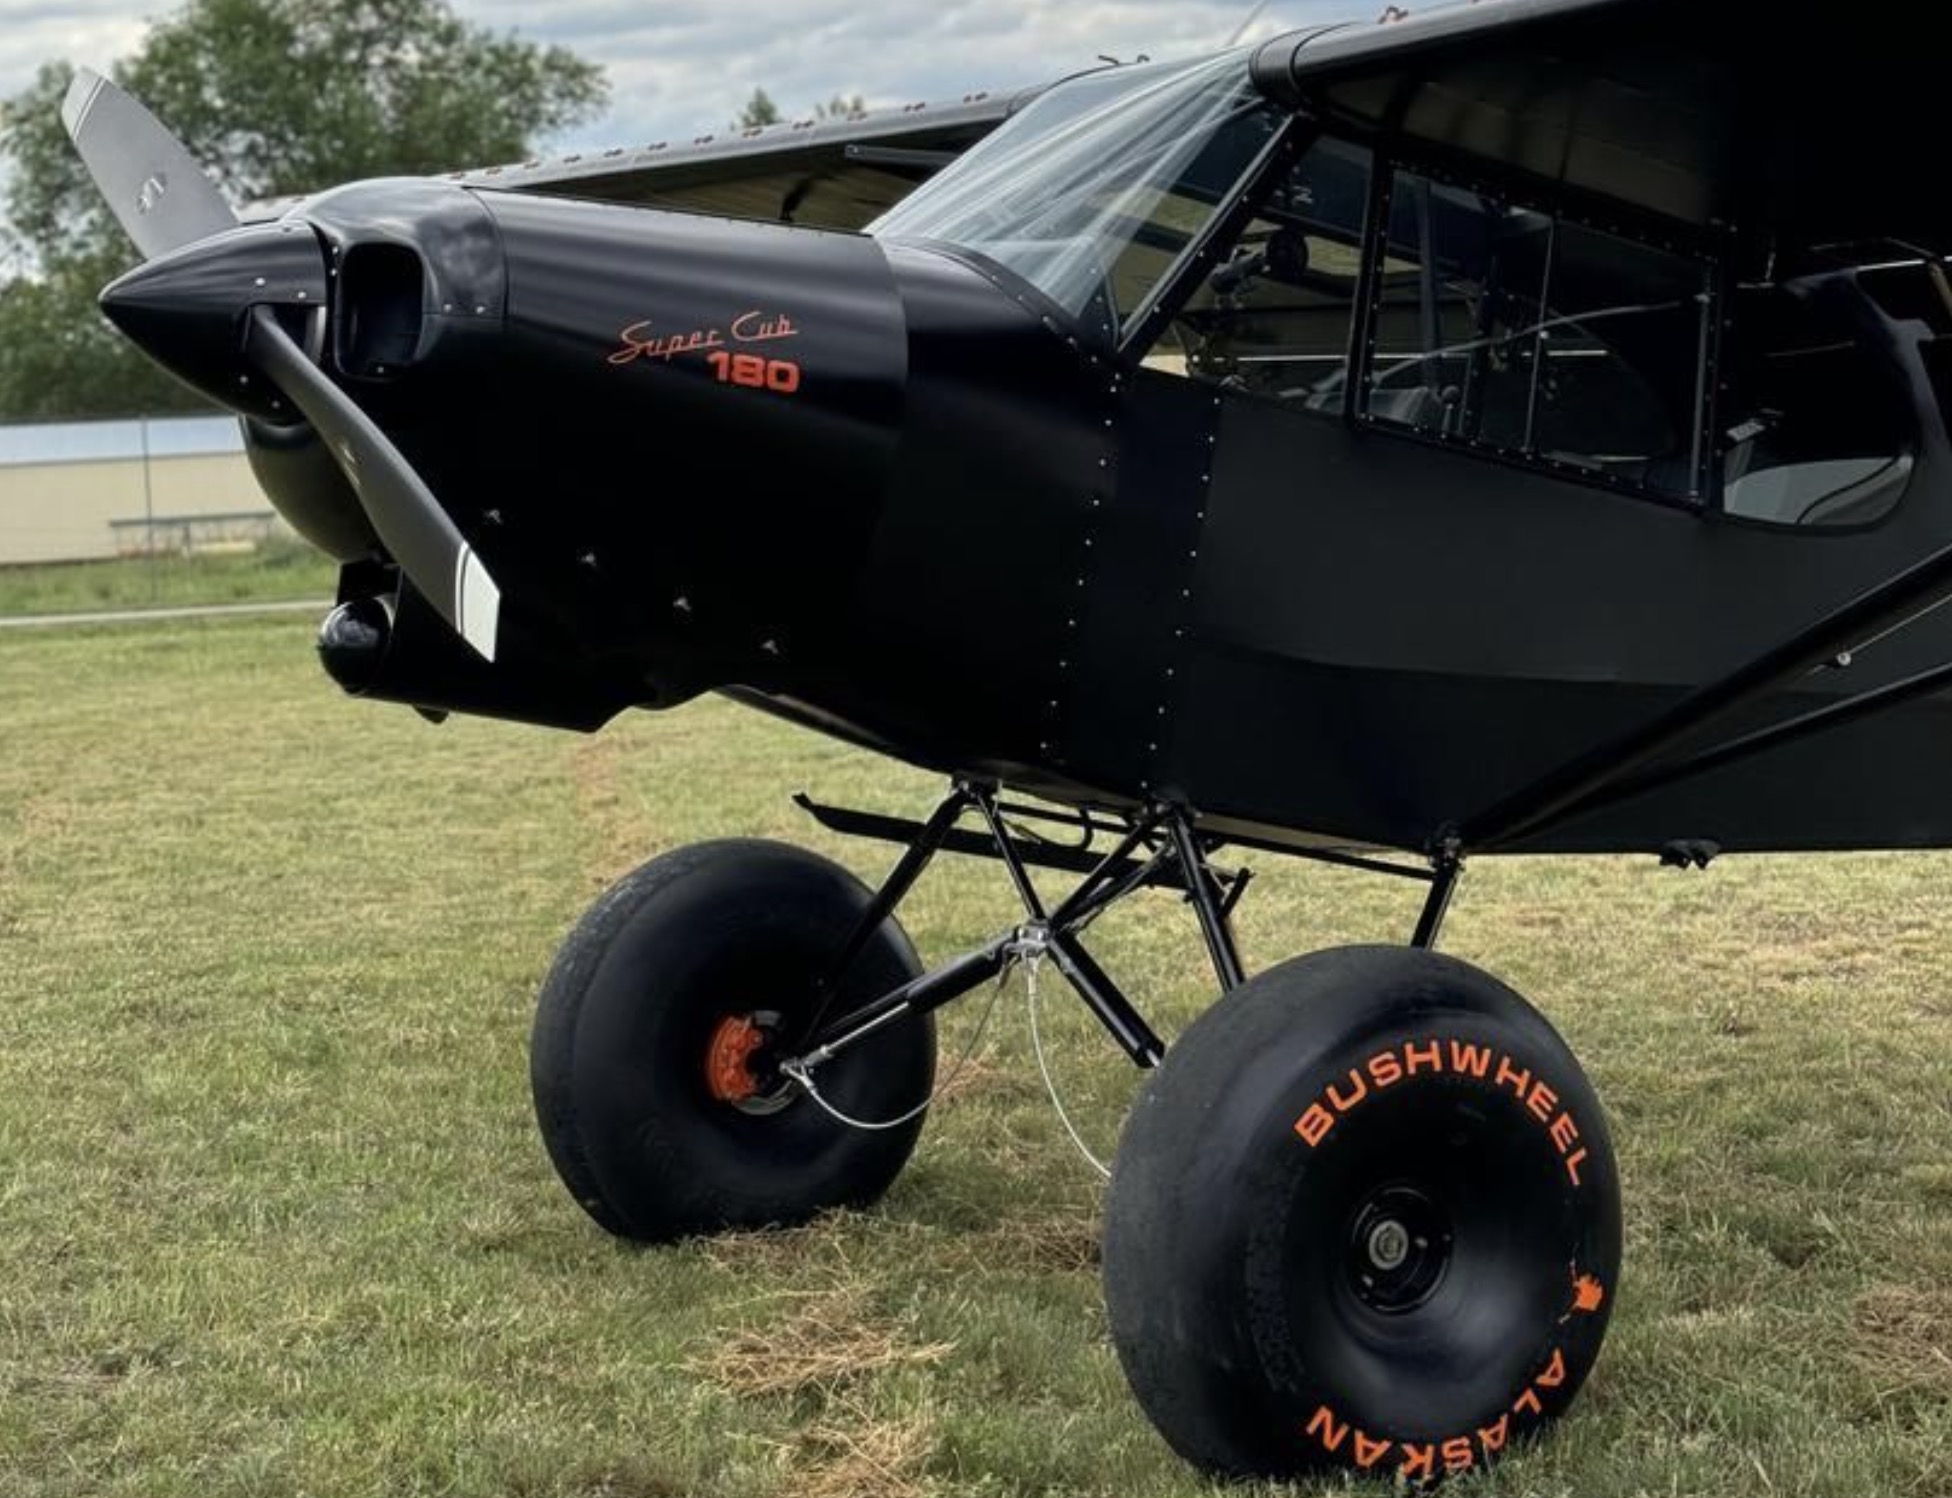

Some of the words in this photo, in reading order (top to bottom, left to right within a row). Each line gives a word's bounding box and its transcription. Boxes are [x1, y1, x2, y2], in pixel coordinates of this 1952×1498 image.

[608, 320, 724, 364] Super
[731, 311, 798, 341] Cub
[707, 351, 799, 392] 180
[1294, 1040, 1587, 1186] BUSHWHEEL
[1307, 1348, 1564, 1480] ALASKAN
